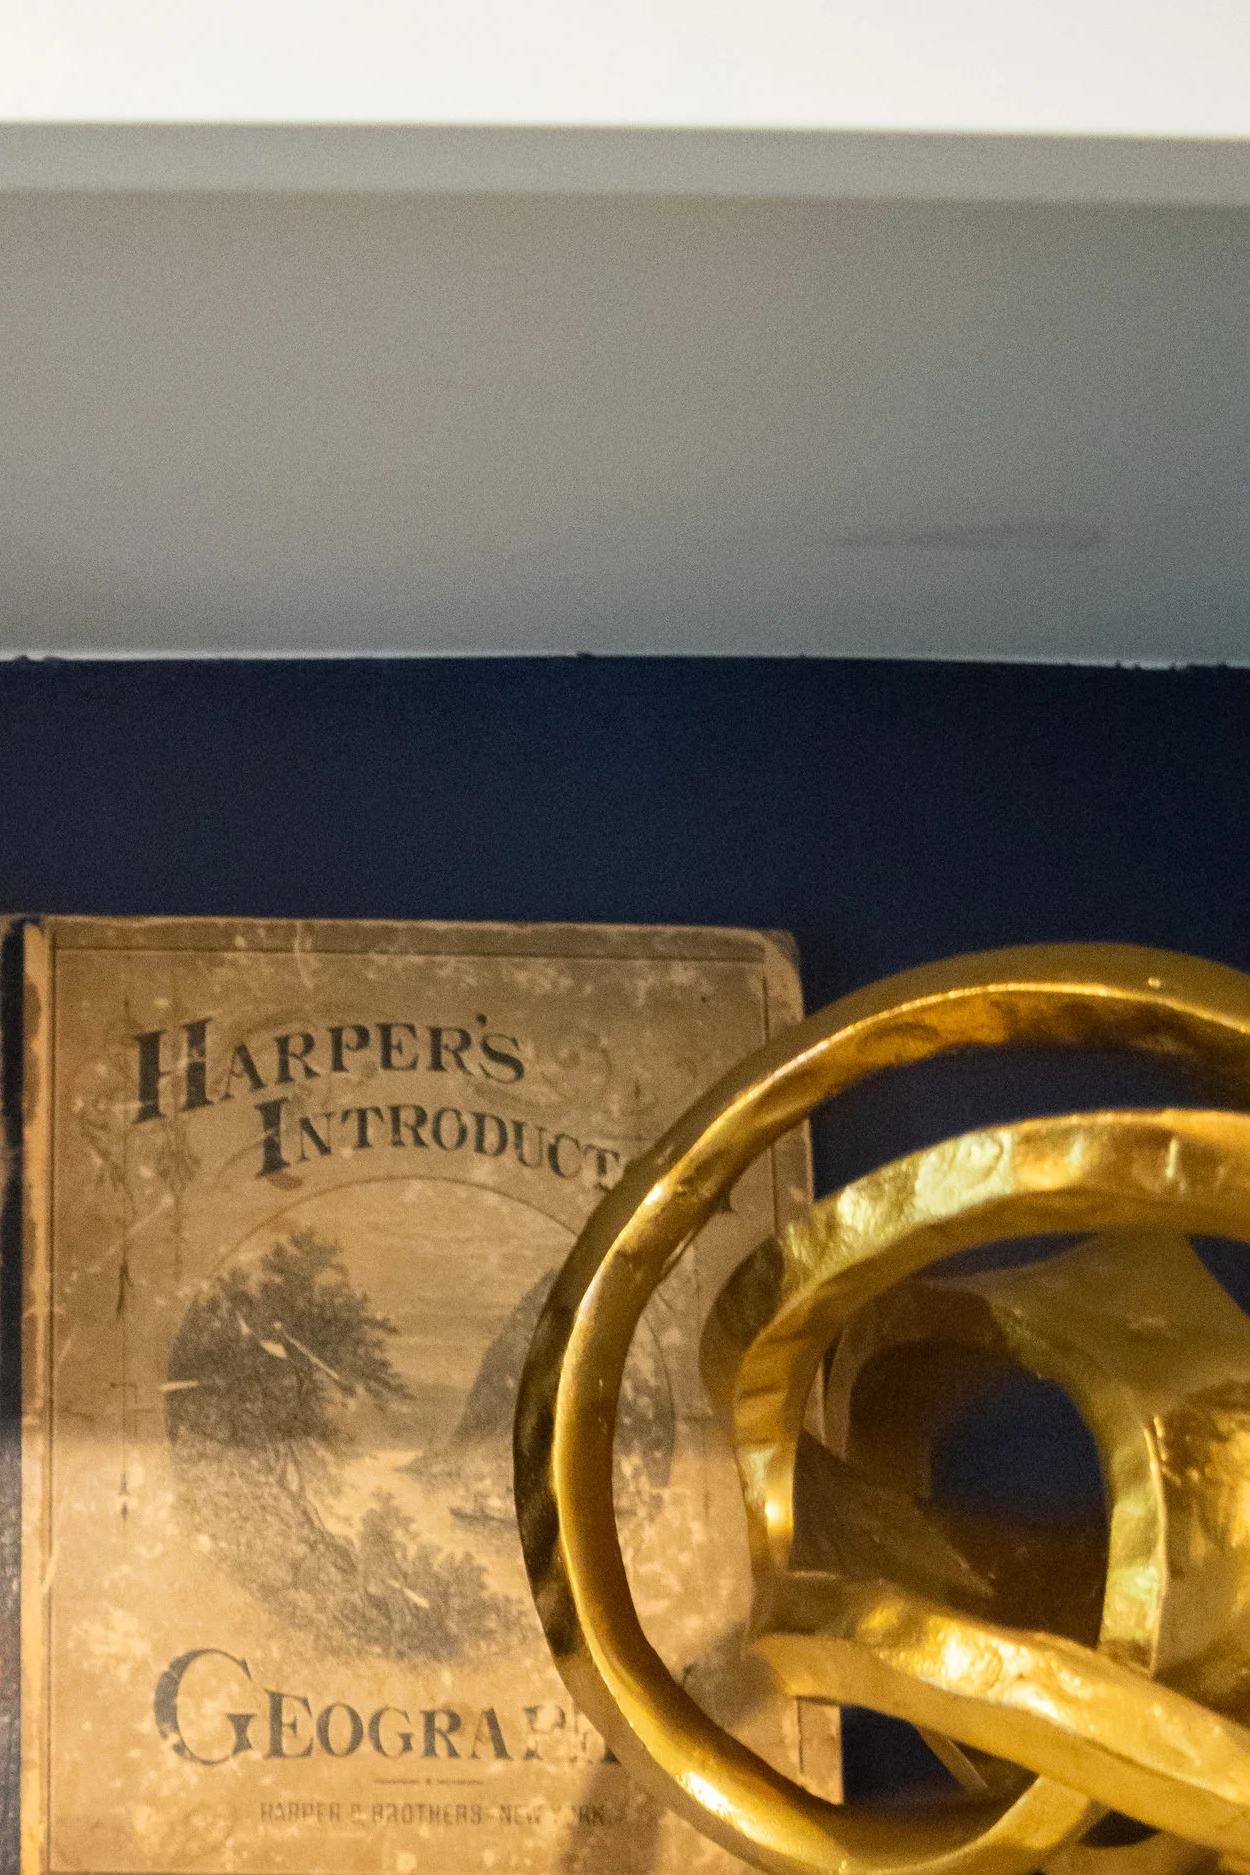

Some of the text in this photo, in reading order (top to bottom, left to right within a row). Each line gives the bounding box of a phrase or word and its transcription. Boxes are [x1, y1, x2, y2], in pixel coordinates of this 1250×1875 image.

[132, 1013, 526, 1123] HARPER'S
[254, 1096, 622, 1191] INTRODUCT
[152, 1649, 622, 1766] GEOGRAP
[260, 1801, 342, 1823] HARPER
